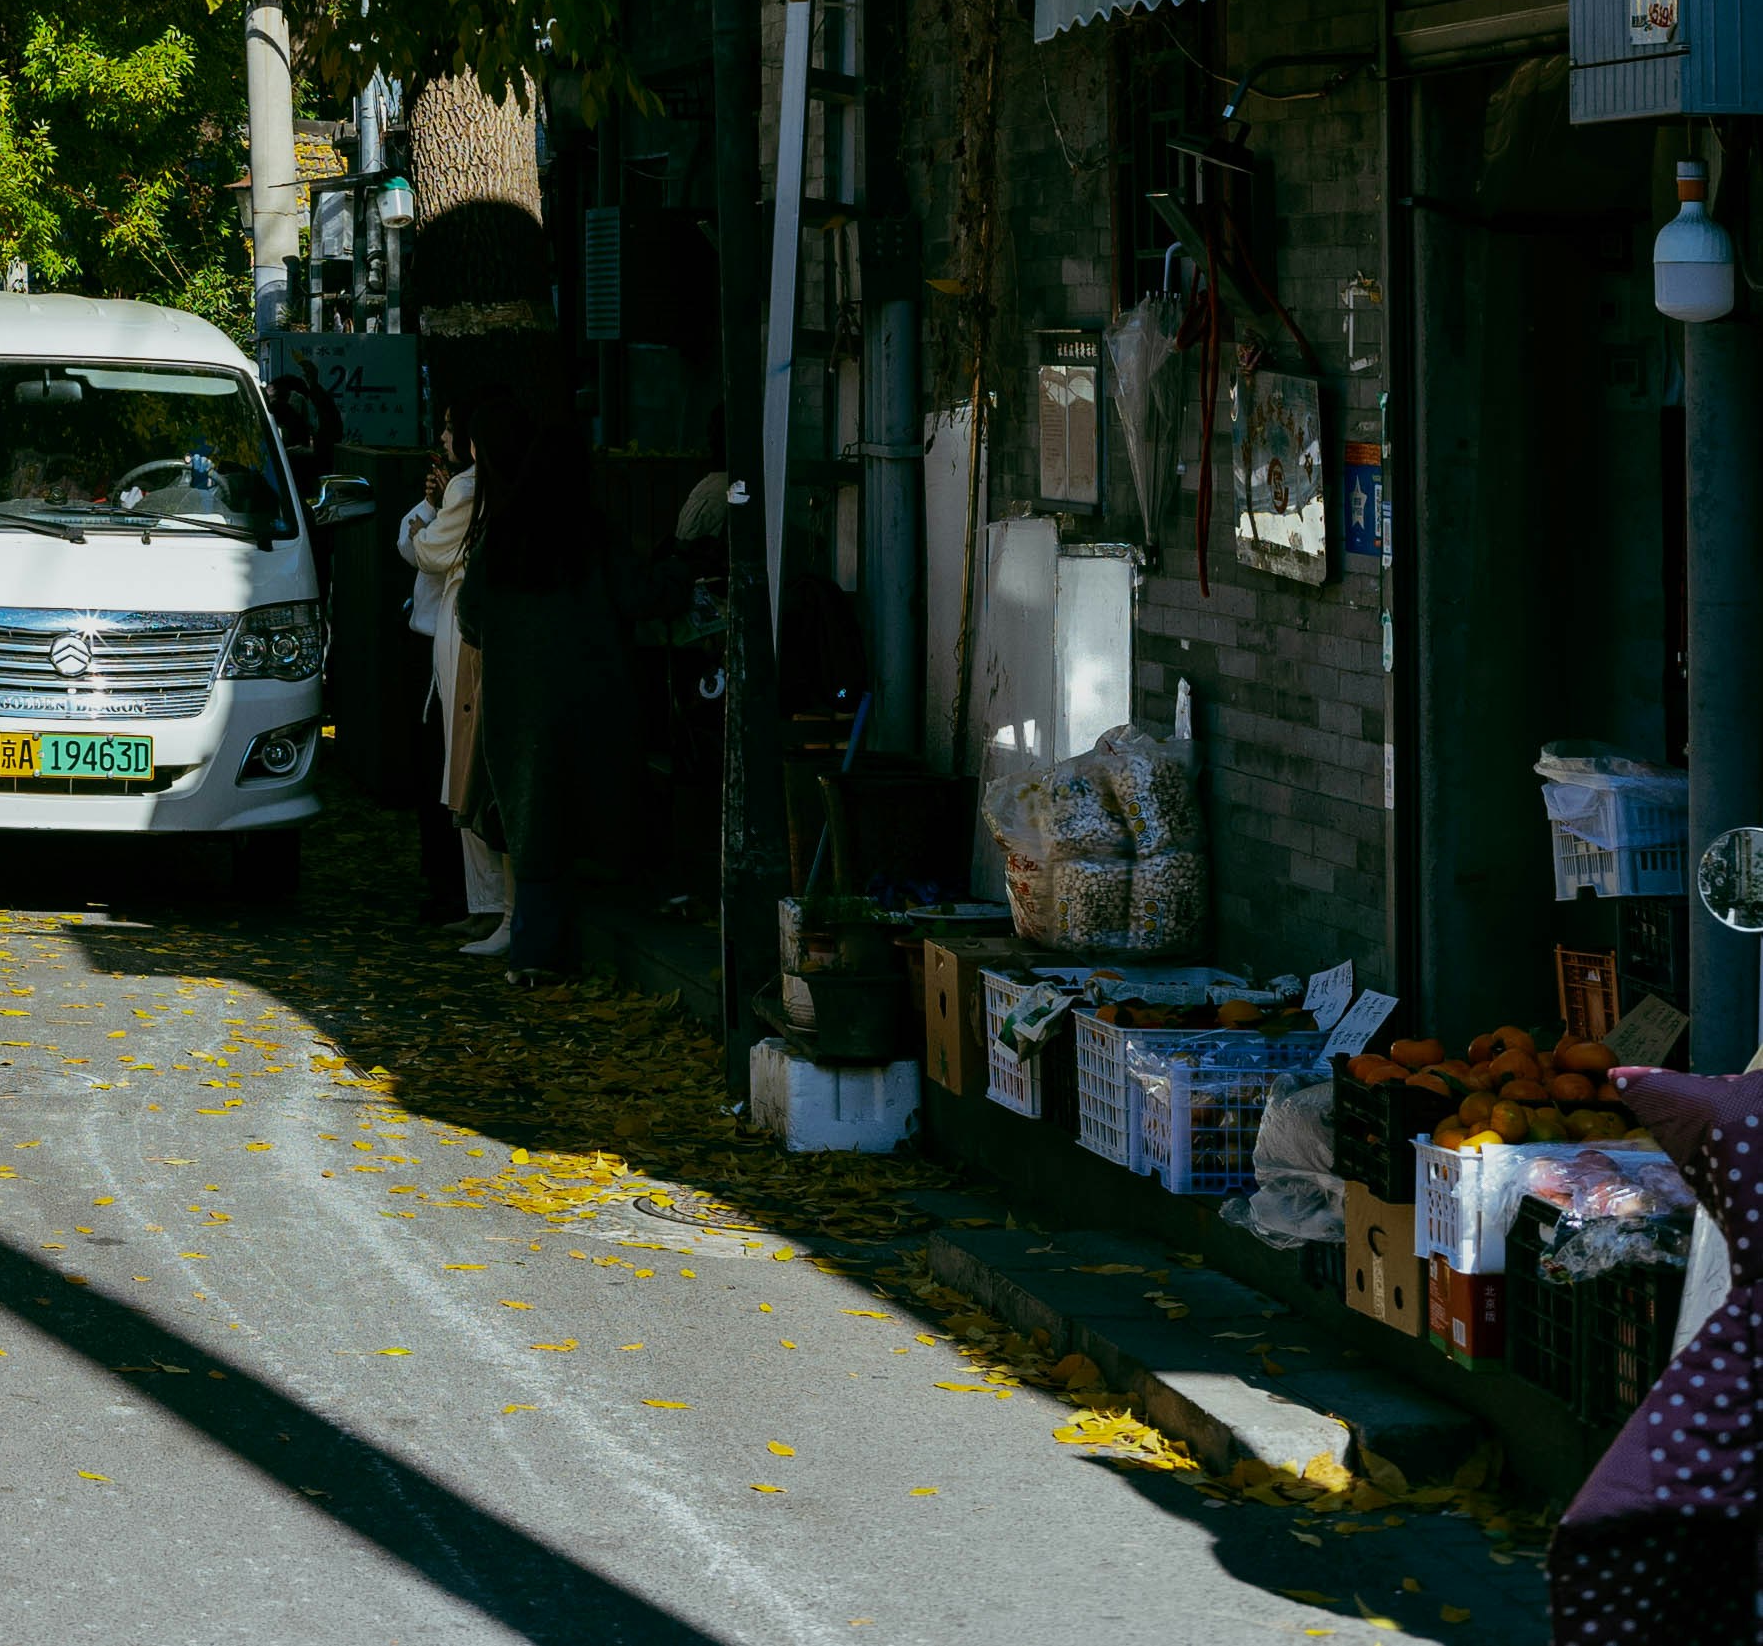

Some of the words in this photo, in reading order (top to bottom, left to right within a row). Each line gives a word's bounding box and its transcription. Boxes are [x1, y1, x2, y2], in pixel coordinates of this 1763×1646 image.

[75, 698, 146, 713] DRAGON
[1, 739, 34, 770] 京A
[51, 740, 149, 773] 19463D
